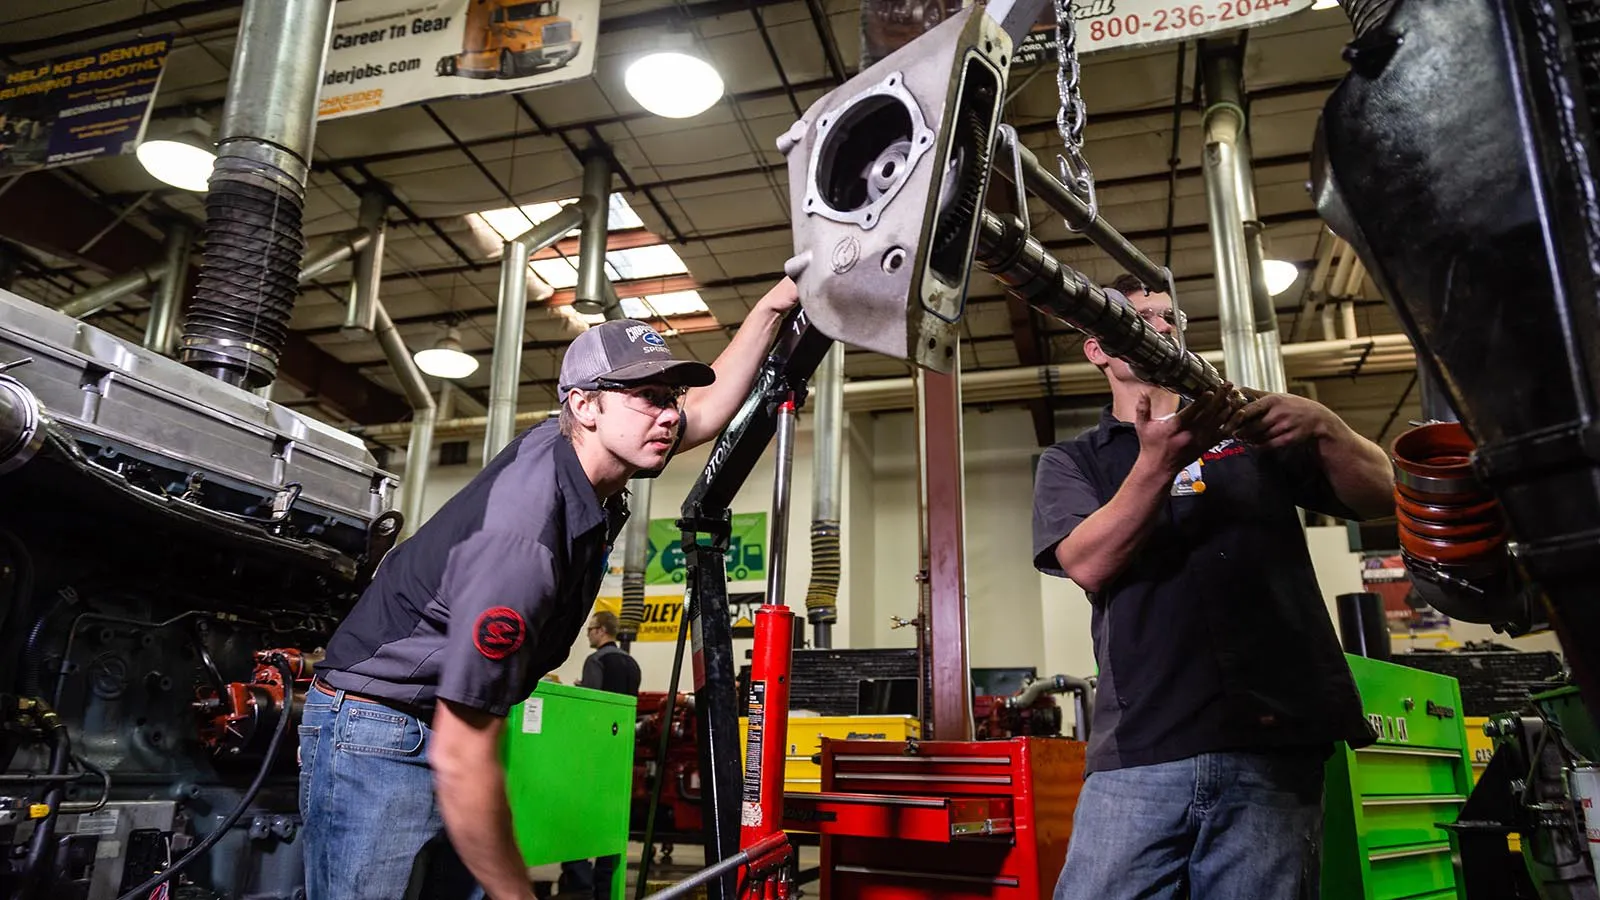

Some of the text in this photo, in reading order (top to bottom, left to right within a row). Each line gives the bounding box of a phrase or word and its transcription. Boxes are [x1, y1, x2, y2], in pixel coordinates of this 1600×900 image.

[332, 28, 387, 50] Career
[411, 16, 452, 35] Gear
[0, 76, 73, 99] RUNNING
[76, 56, 169, 84] SMOOTHLY
[6, 41, 167, 83] HELP KEEP DENVER
[322, 58, 421, 86] iderjobs.com
[792, 308, 807, 335] 1T
[643, 603, 683, 623] OLEY
